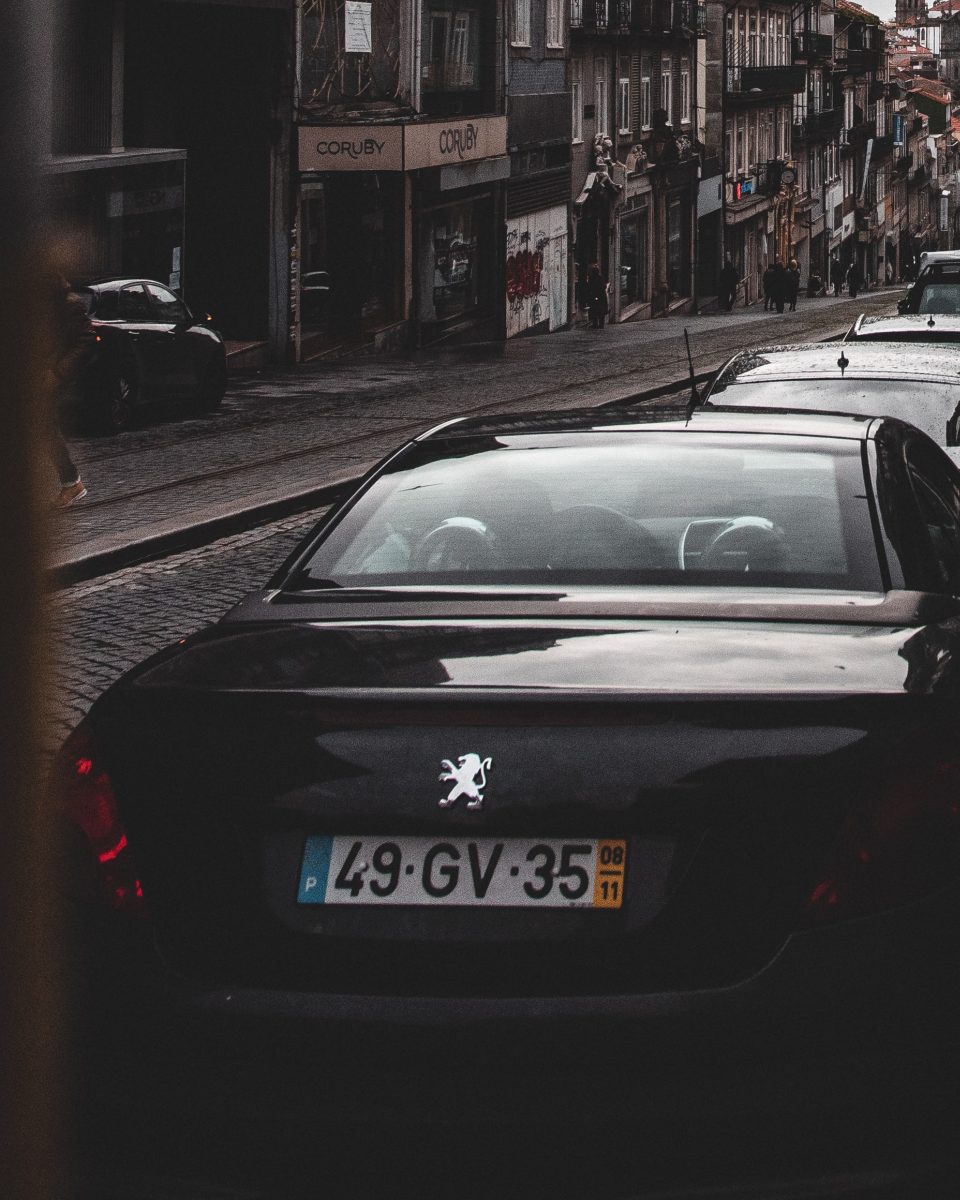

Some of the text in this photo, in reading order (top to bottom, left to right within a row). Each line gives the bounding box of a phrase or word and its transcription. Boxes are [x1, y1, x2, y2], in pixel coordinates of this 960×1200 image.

[316, 138, 386, 160] CORUBY
[439, 123, 479, 160] CORUBY
[601, 845, 623, 866] 08
[304, 877, 317, 893] P
[601, 880, 619, 901] 11
